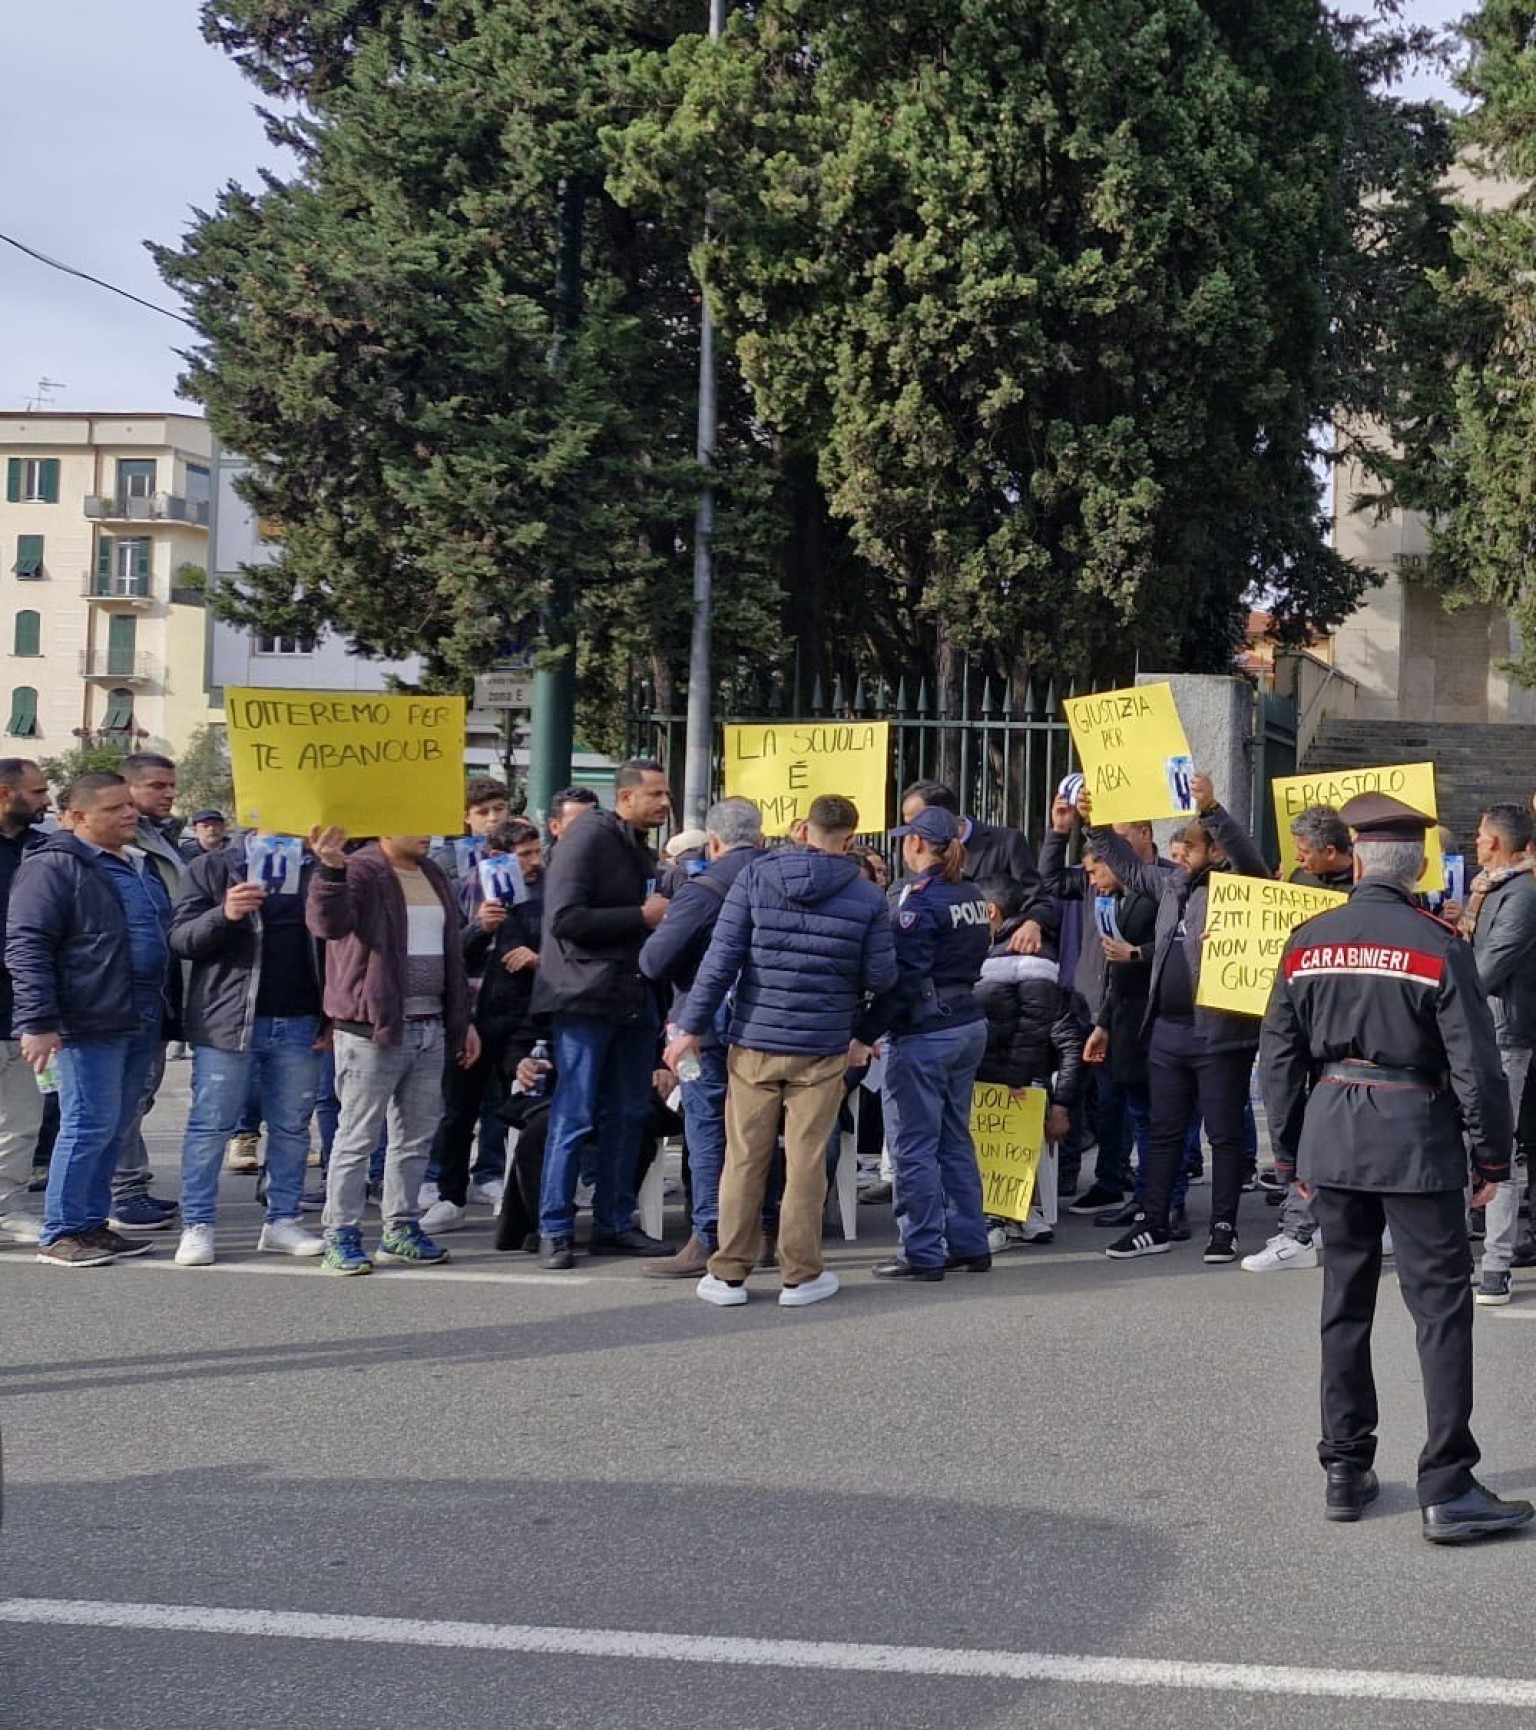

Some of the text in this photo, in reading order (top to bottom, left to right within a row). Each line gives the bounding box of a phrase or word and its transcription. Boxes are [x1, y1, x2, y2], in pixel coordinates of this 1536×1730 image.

[408, 704, 450, 727] PER
[1073, 695, 1154, 733] GIUSTIZIA
[737, 726, 875, 760] LA SCUOLA
[1101, 727, 1124, 750] PER
[251, 738, 443, 772] TE ABANOUB
[1096, 763, 1131, 796] ABA
[1212, 883, 1251, 904] NON
[949, 900, 990, 928] POLIZ
[1208, 910, 1251, 932] ZITTI
[1208, 938, 1247, 960] NON
[1301, 947, 1410, 971] CARABINIERI
[1220, 961, 1278, 990] GIUST
[973, 1088, 1022, 1111] UOLA
[981, 1142, 1000, 1159] UN
